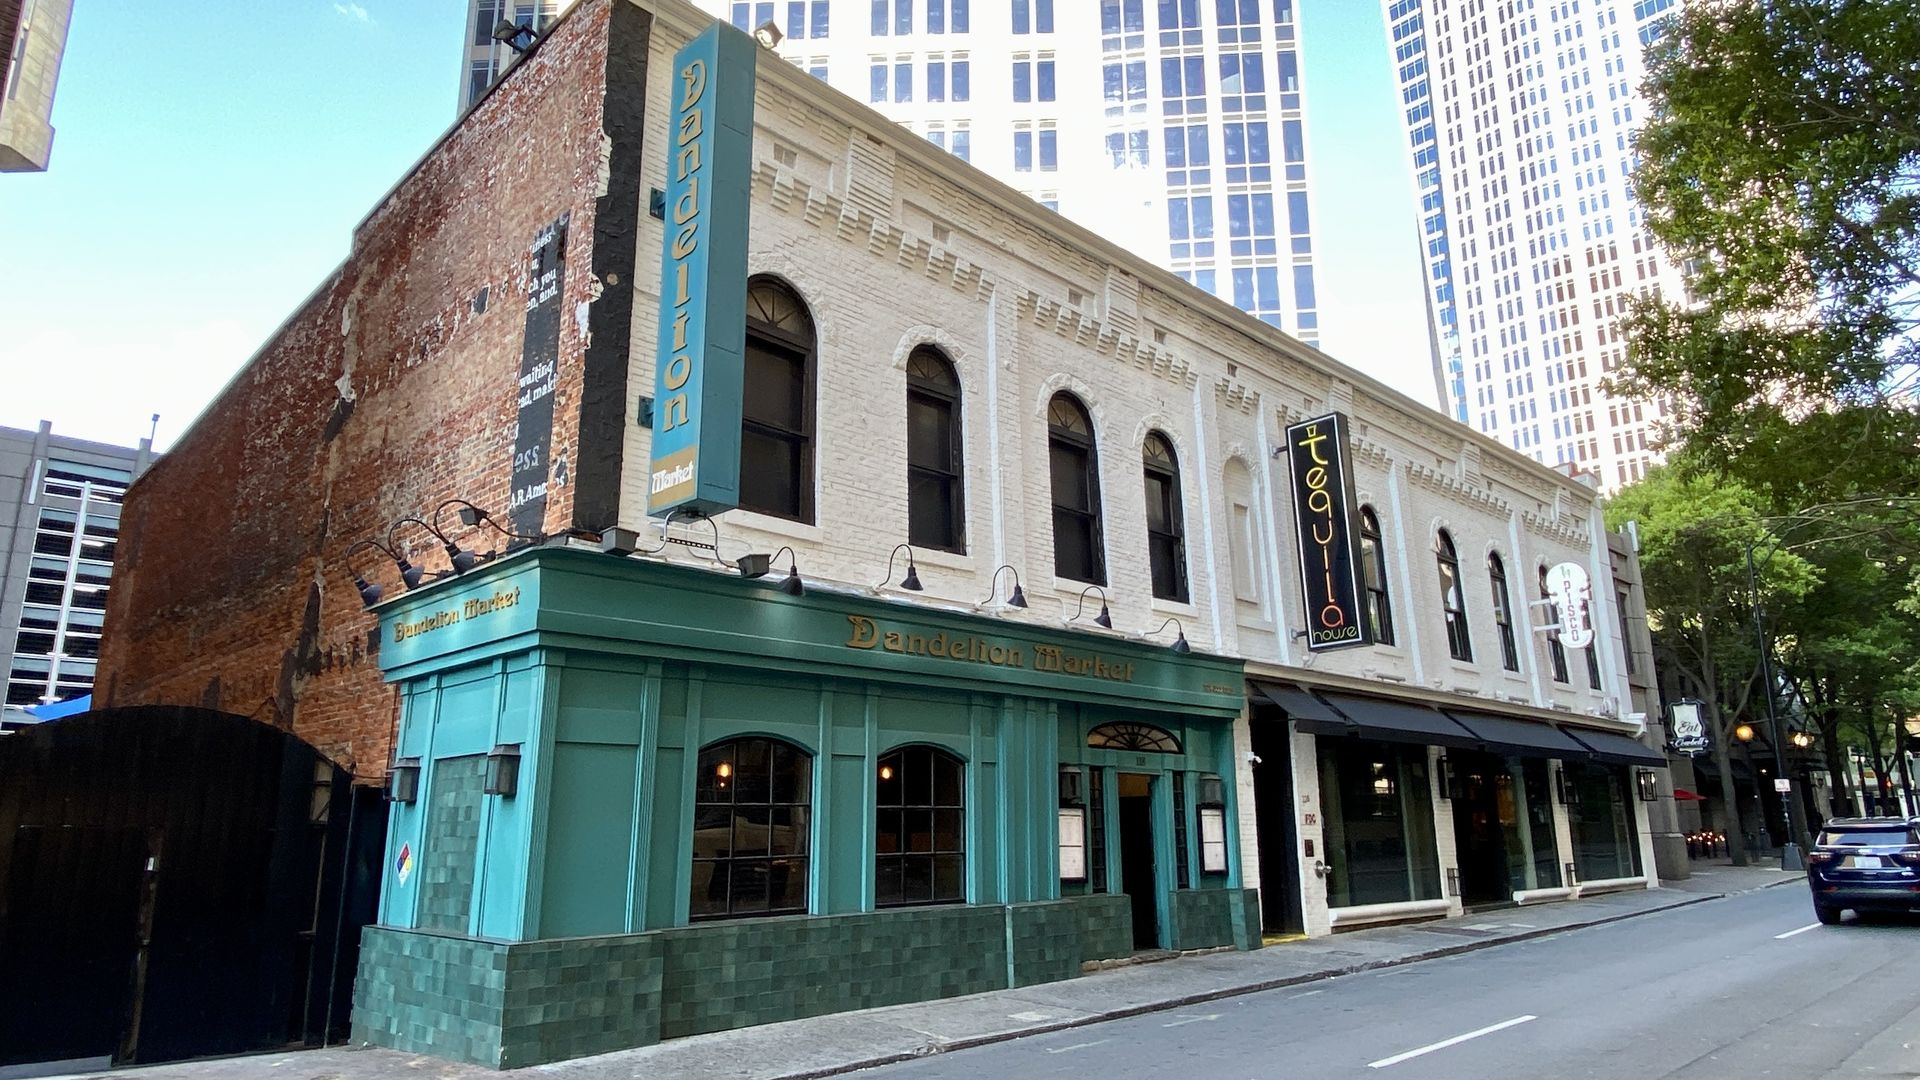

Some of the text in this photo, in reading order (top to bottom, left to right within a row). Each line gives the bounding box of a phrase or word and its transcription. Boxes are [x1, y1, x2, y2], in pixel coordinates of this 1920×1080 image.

[662, 58, 708, 433] Dandelion
[540, 268, 557, 290] you
[519, 359, 554, 389] waiting
[514, 444, 540, 473] ess
[651, 459, 694, 494] Market
[1298, 434, 1344, 628] tequila
[393, 585, 521, 643] Dandelion Market
[1563, 580, 1579, 642] PISCO
[846, 614, 1136, 683] Dandelion Market
[1312, 625, 1357, 642] house
[1677, 720, 1700, 734] Eat
